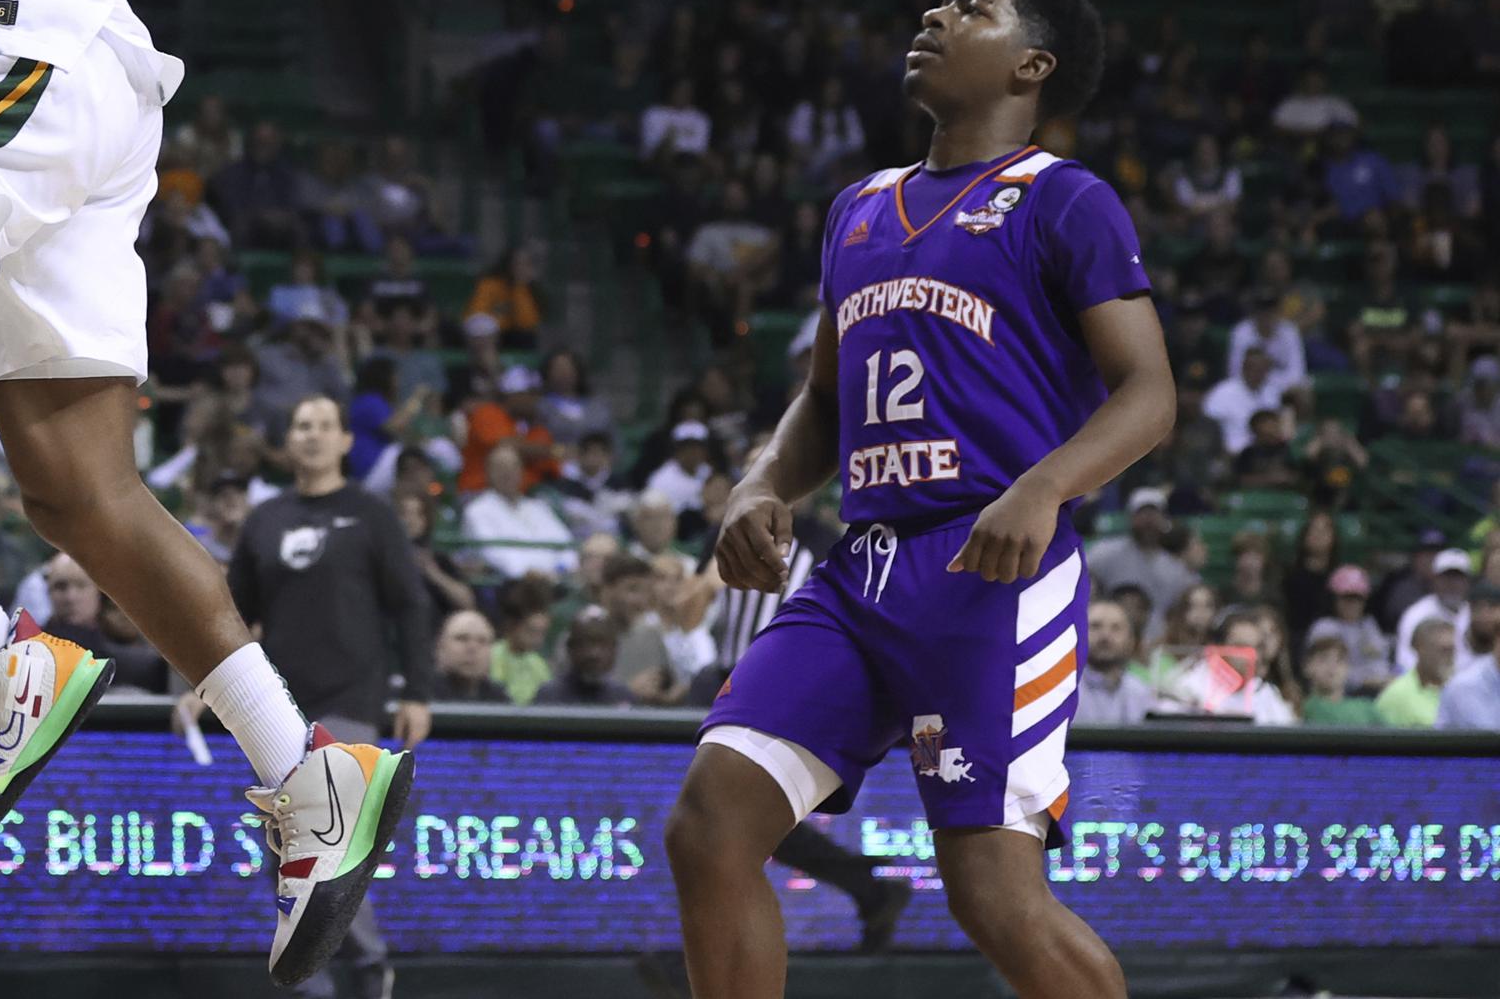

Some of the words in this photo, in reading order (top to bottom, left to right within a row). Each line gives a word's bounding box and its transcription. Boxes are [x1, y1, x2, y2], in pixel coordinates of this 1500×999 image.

[863, 349, 925, 427] 12
[849, 439, 961, 492] STATE
[46, 810, 214, 876] BUILD
[415, 815, 644, 880] DREAMS
[1179, 822, 1309, 882] BUILD
[1320, 824, 1447, 882] SOME
